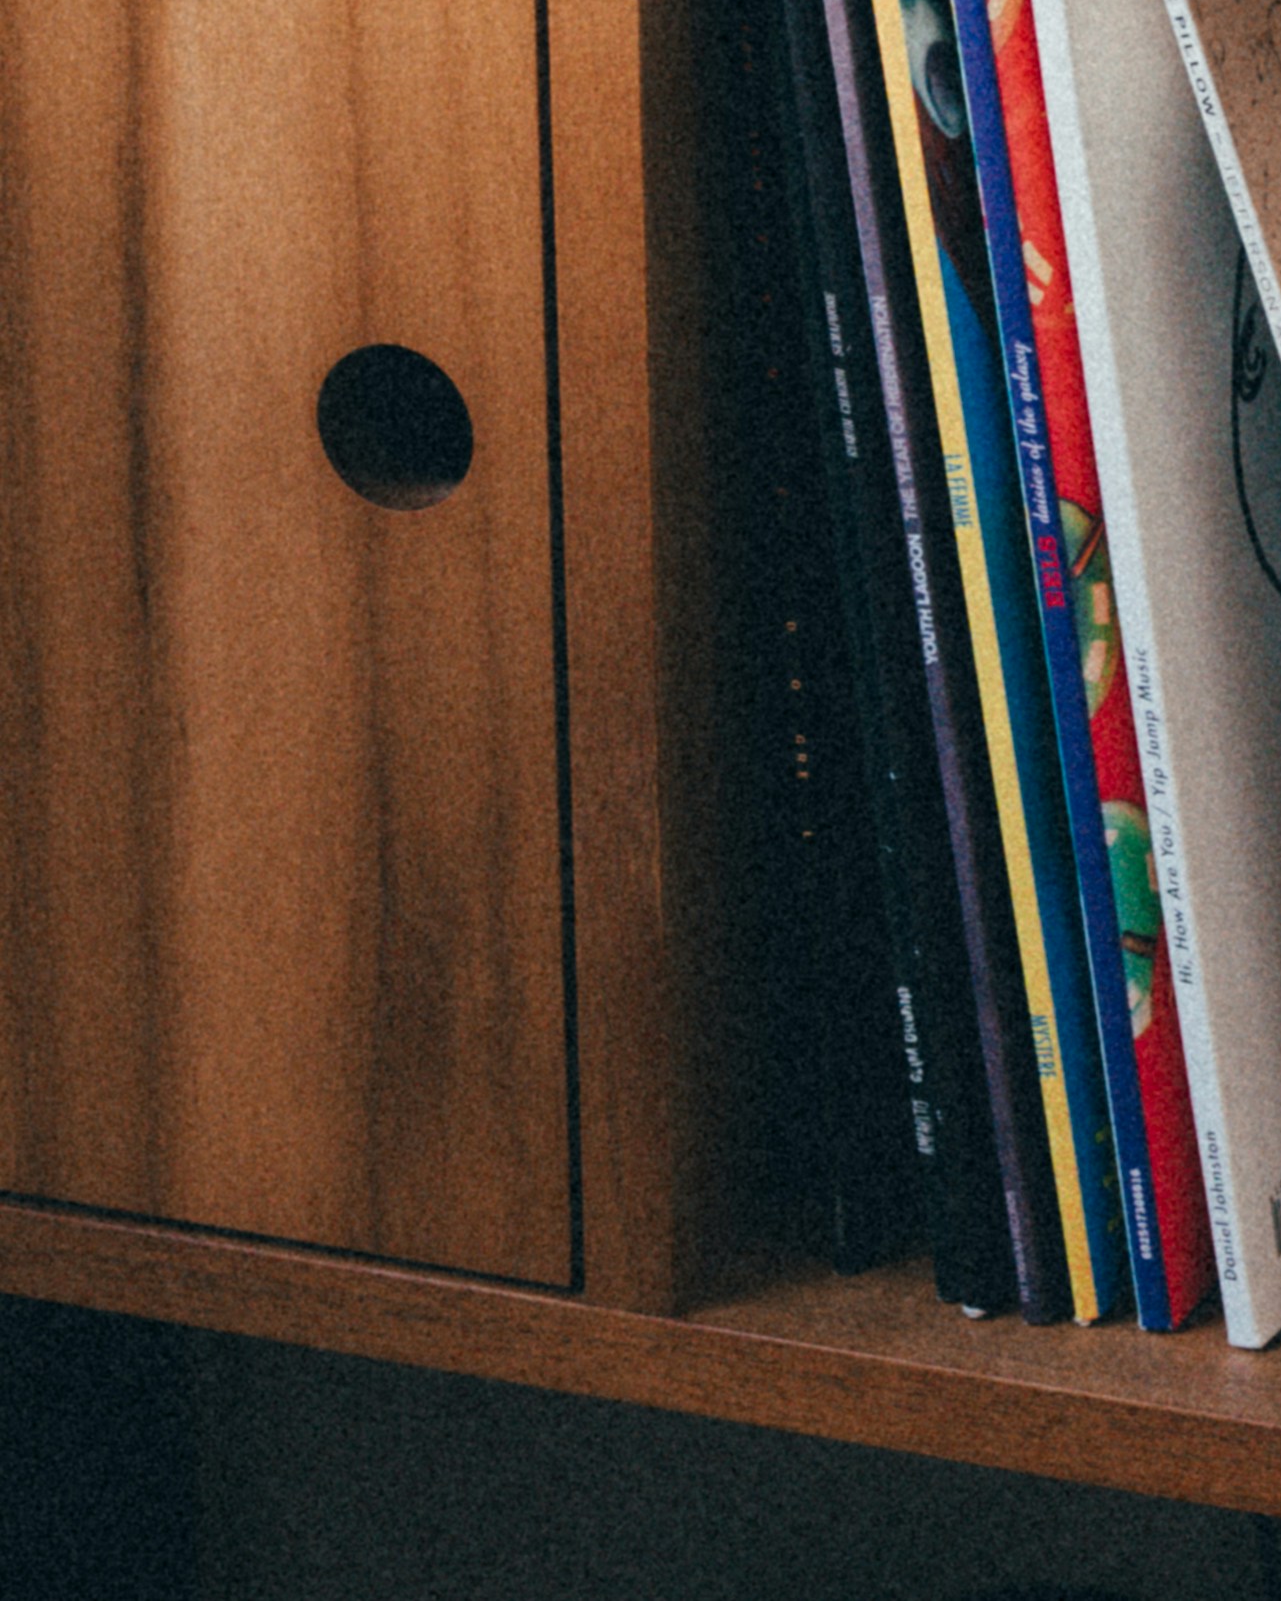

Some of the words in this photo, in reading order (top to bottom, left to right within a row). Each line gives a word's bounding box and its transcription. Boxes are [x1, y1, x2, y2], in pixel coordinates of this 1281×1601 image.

[1174, 14, 1216, 118] PILLOW
[1010, 339, 1039, 402] galaxy
[887, 411, 906, 436] OF
[1017, 406, 1038, 435] the
[890, 436, 915, 486] YEAR
[943, 453, 964, 473] LA
[1020, 439, 1046, 460] of
[900, 487, 919, 522] THE
[948, 477, 974, 529] FEMME
[907, 533, 931, 605] LAGOON
[918, 607, 939, 666] YOUTH
[1132, 647, 1153, 703] Music
[1145, 710, 1162, 760] Jump
[1151, 767, 1169, 796] Yip
[1160, 824, 1176, 858] You
[1166, 866, 1184, 901] Are
[1173, 908, 1190, 952] How
[1206, 1129, 1229, 1214] Johnston
[1214, 1220, 1238, 1283] Daniel
